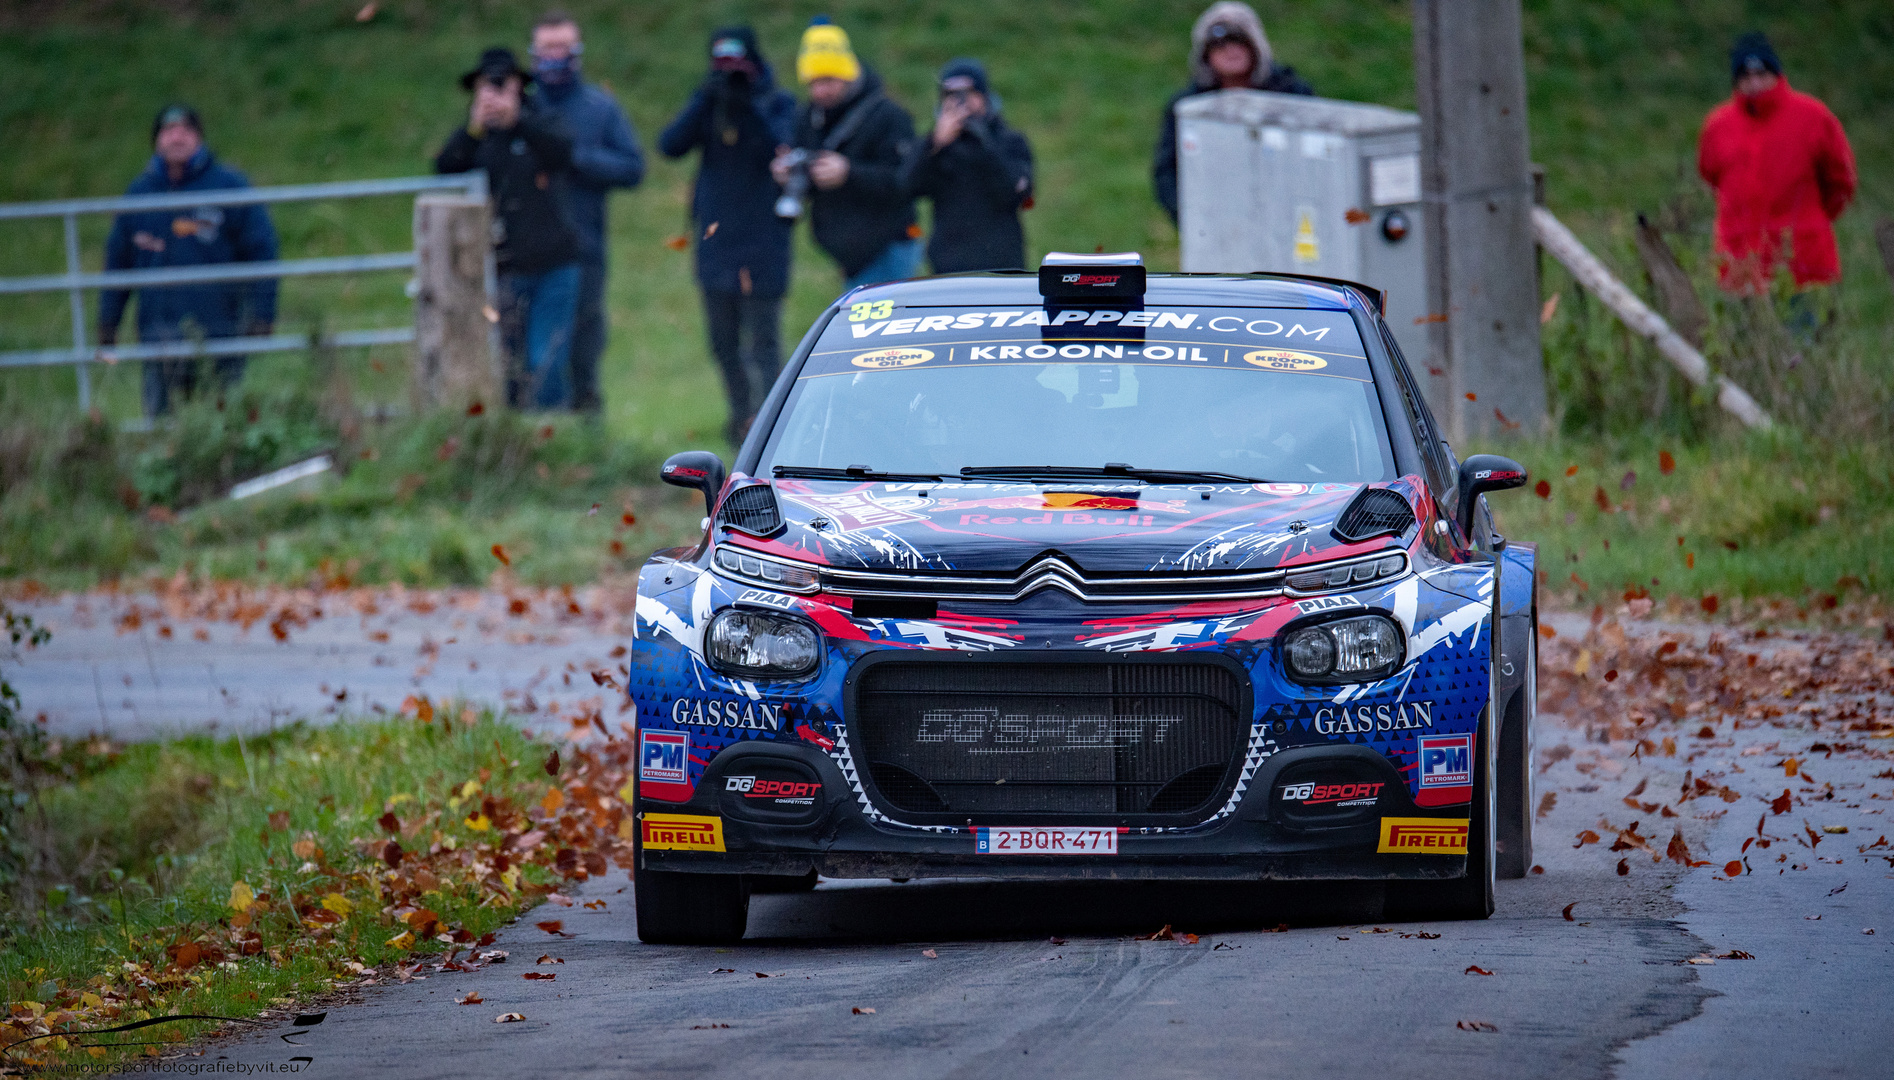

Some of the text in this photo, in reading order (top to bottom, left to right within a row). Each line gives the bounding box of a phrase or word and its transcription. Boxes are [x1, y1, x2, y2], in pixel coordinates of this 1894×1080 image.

[848, 299, 895, 322] 33
[851, 310, 1331, 341] VERSTAPPEN.COM
[863, 353, 923, 363] KROON
[970, 344, 1208, 361] KROON-OIL
[1255, 355, 1315, 365] KROON
[878, 360, 904, 368] OIL
[1270, 362, 1297, 370] OIL
[959, 512, 1154, 527] Red Bull
[741, 590, 791, 607] PIAA
[1298, 596, 1358, 612] PIAA
[672, 698, 781, 731] GASSAN
[1314, 701, 1433, 735] GASSAN
[644, 743, 685, 770] PM
[1423, 747, 1468, 774] PM
[642, 820, 715, 845] PIRELLI
[979, 831, 1112, 849] B 2-BQR-471
[1388, 825, 1468, 847] PIRELLI
